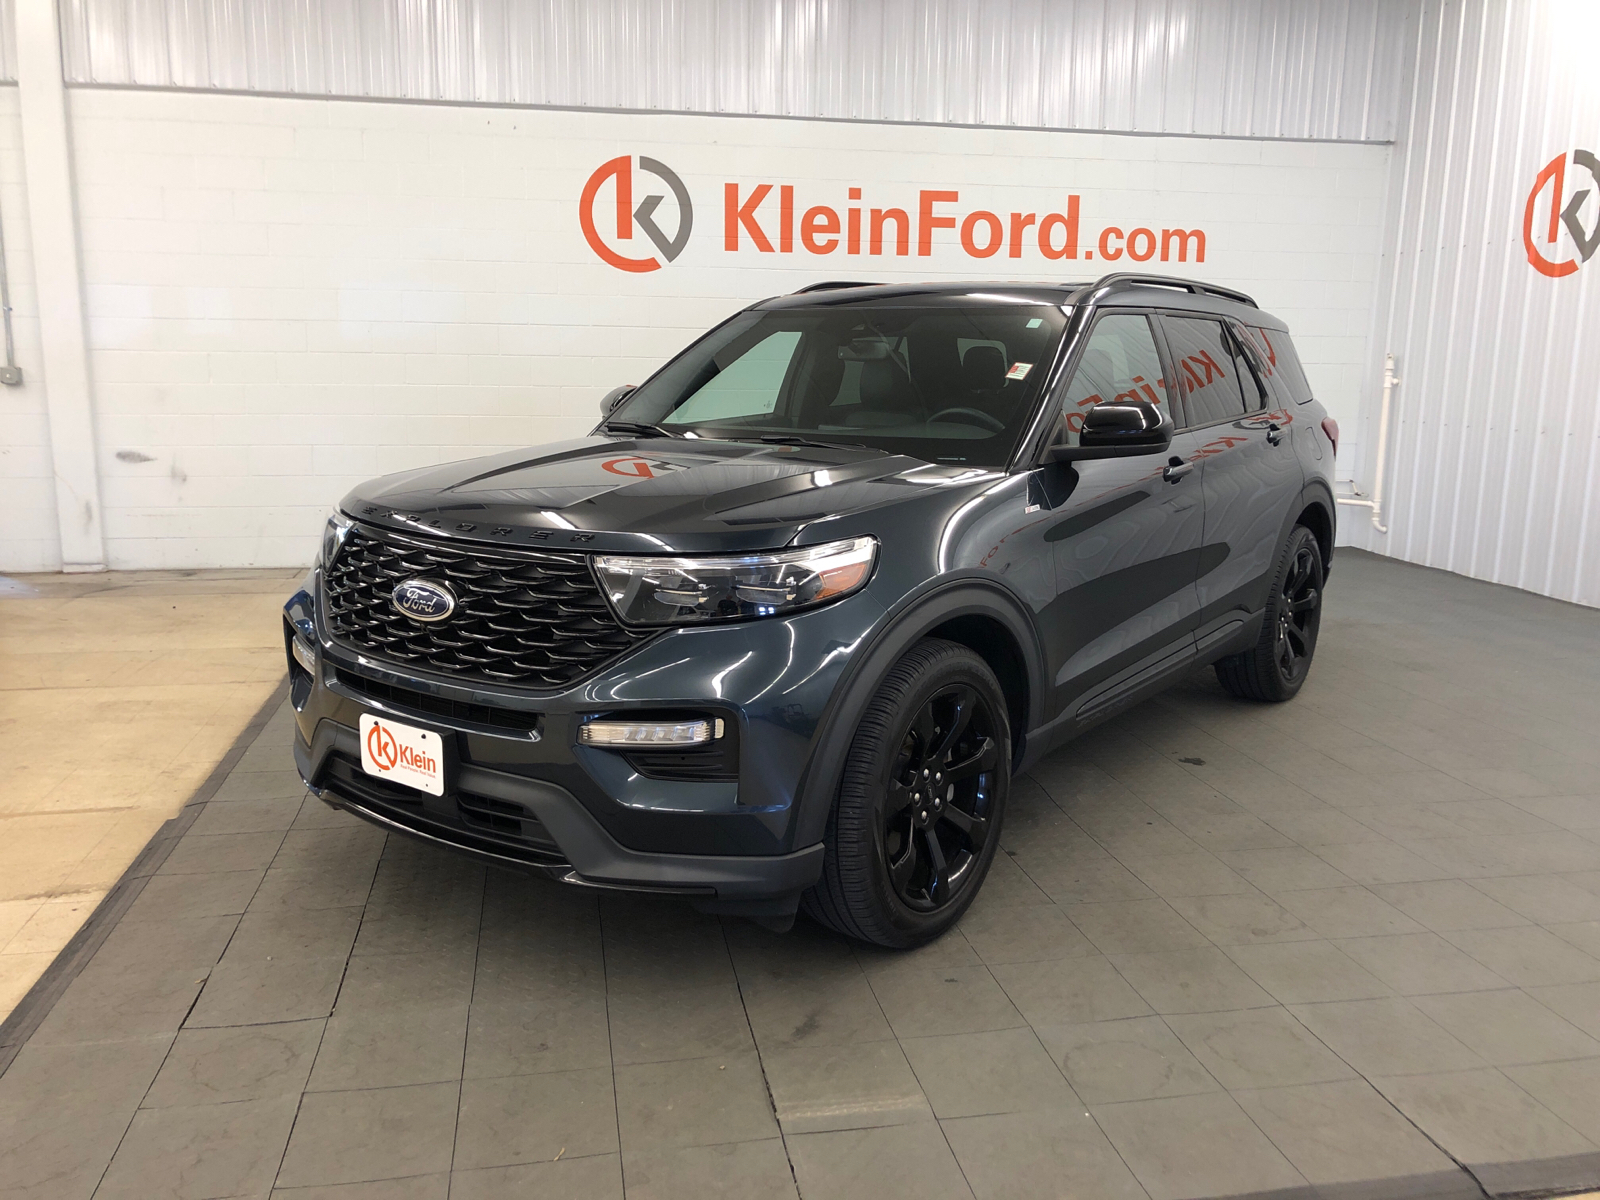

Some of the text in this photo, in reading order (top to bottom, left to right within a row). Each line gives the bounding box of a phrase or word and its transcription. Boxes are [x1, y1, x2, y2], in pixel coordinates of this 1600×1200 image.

[724, 182, 1206, 263] KleinFord.com
[361, 506, 595, 543] EXPLORER
[402, 588, 437, 613] Ford
[399, 744, 436, 773] Klein
